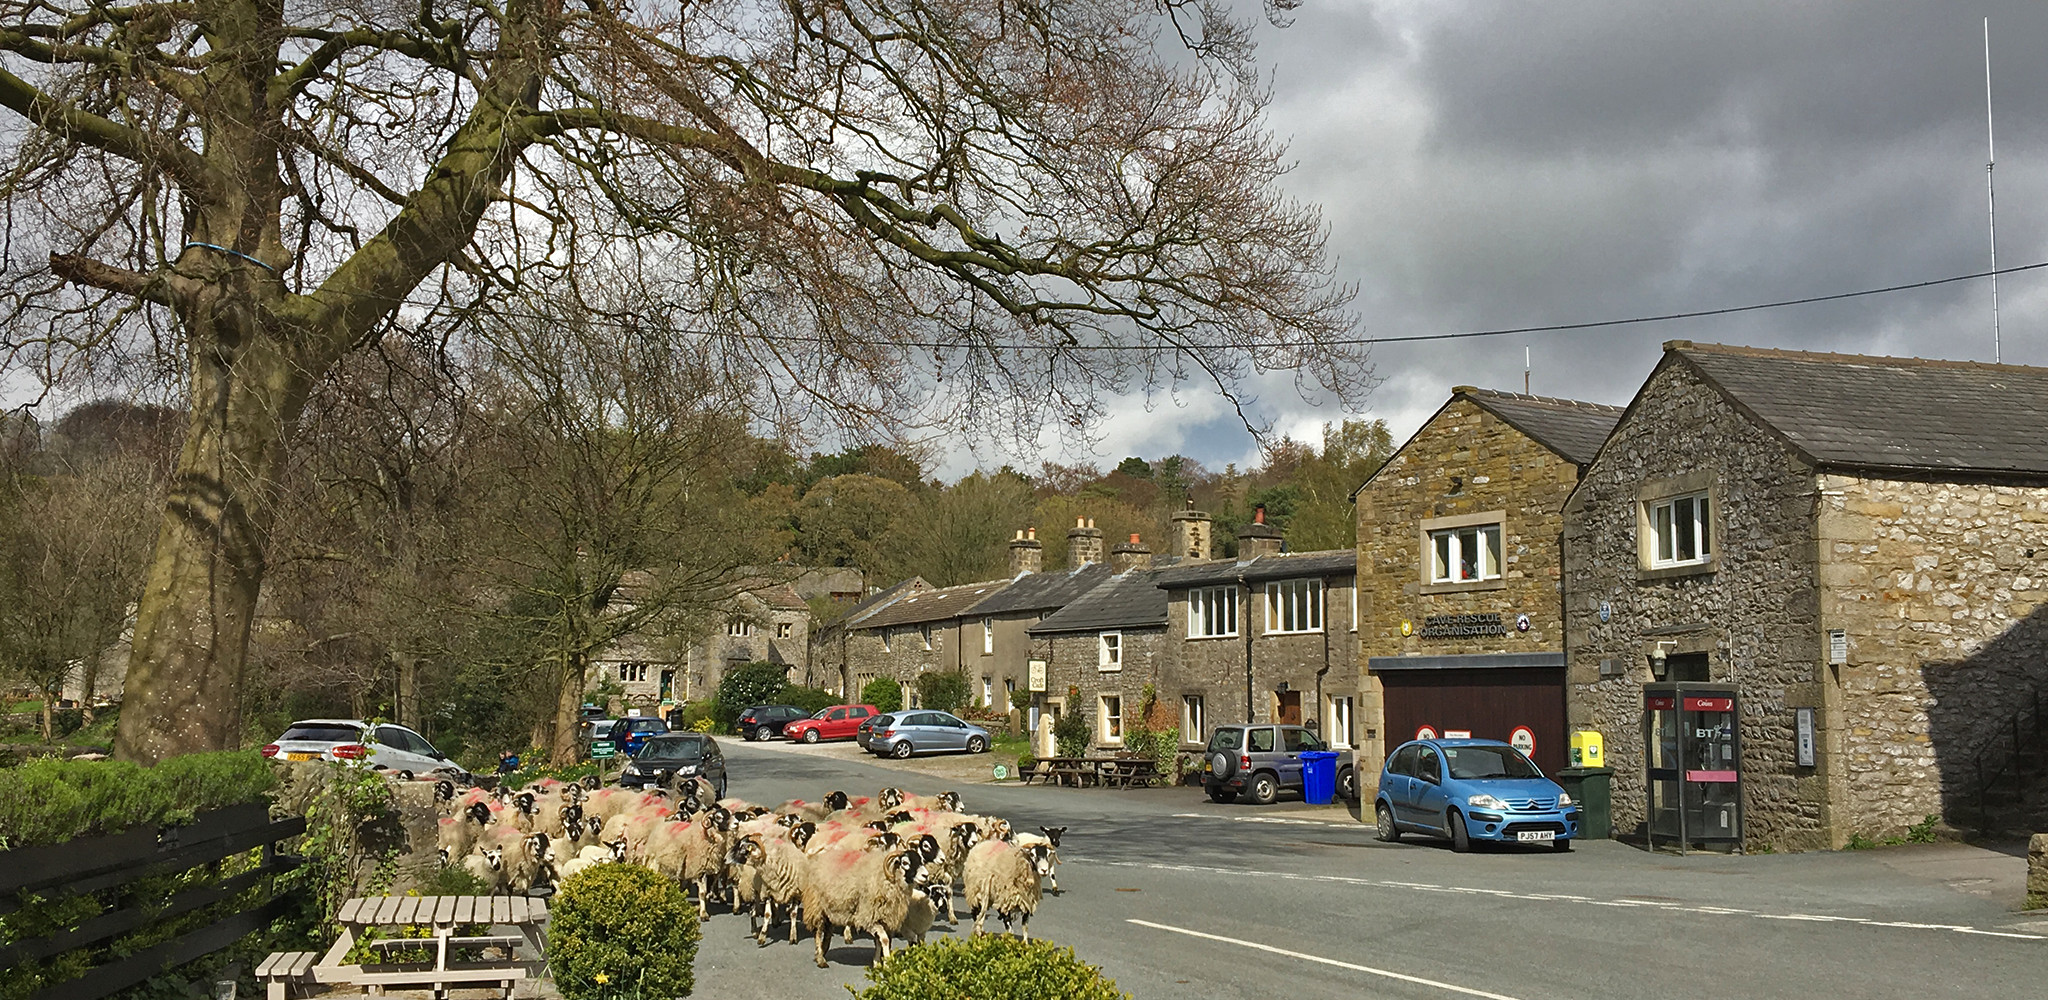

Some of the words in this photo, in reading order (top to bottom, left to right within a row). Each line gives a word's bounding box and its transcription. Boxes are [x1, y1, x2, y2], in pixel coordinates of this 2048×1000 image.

[1425, 615, 1453, 625] CAVE
[1456, 613, 1500, 623] RESCUE
[1420, 624, 1506, 637] ORGANISATION
[1696, 728, 1714, 738] BT
